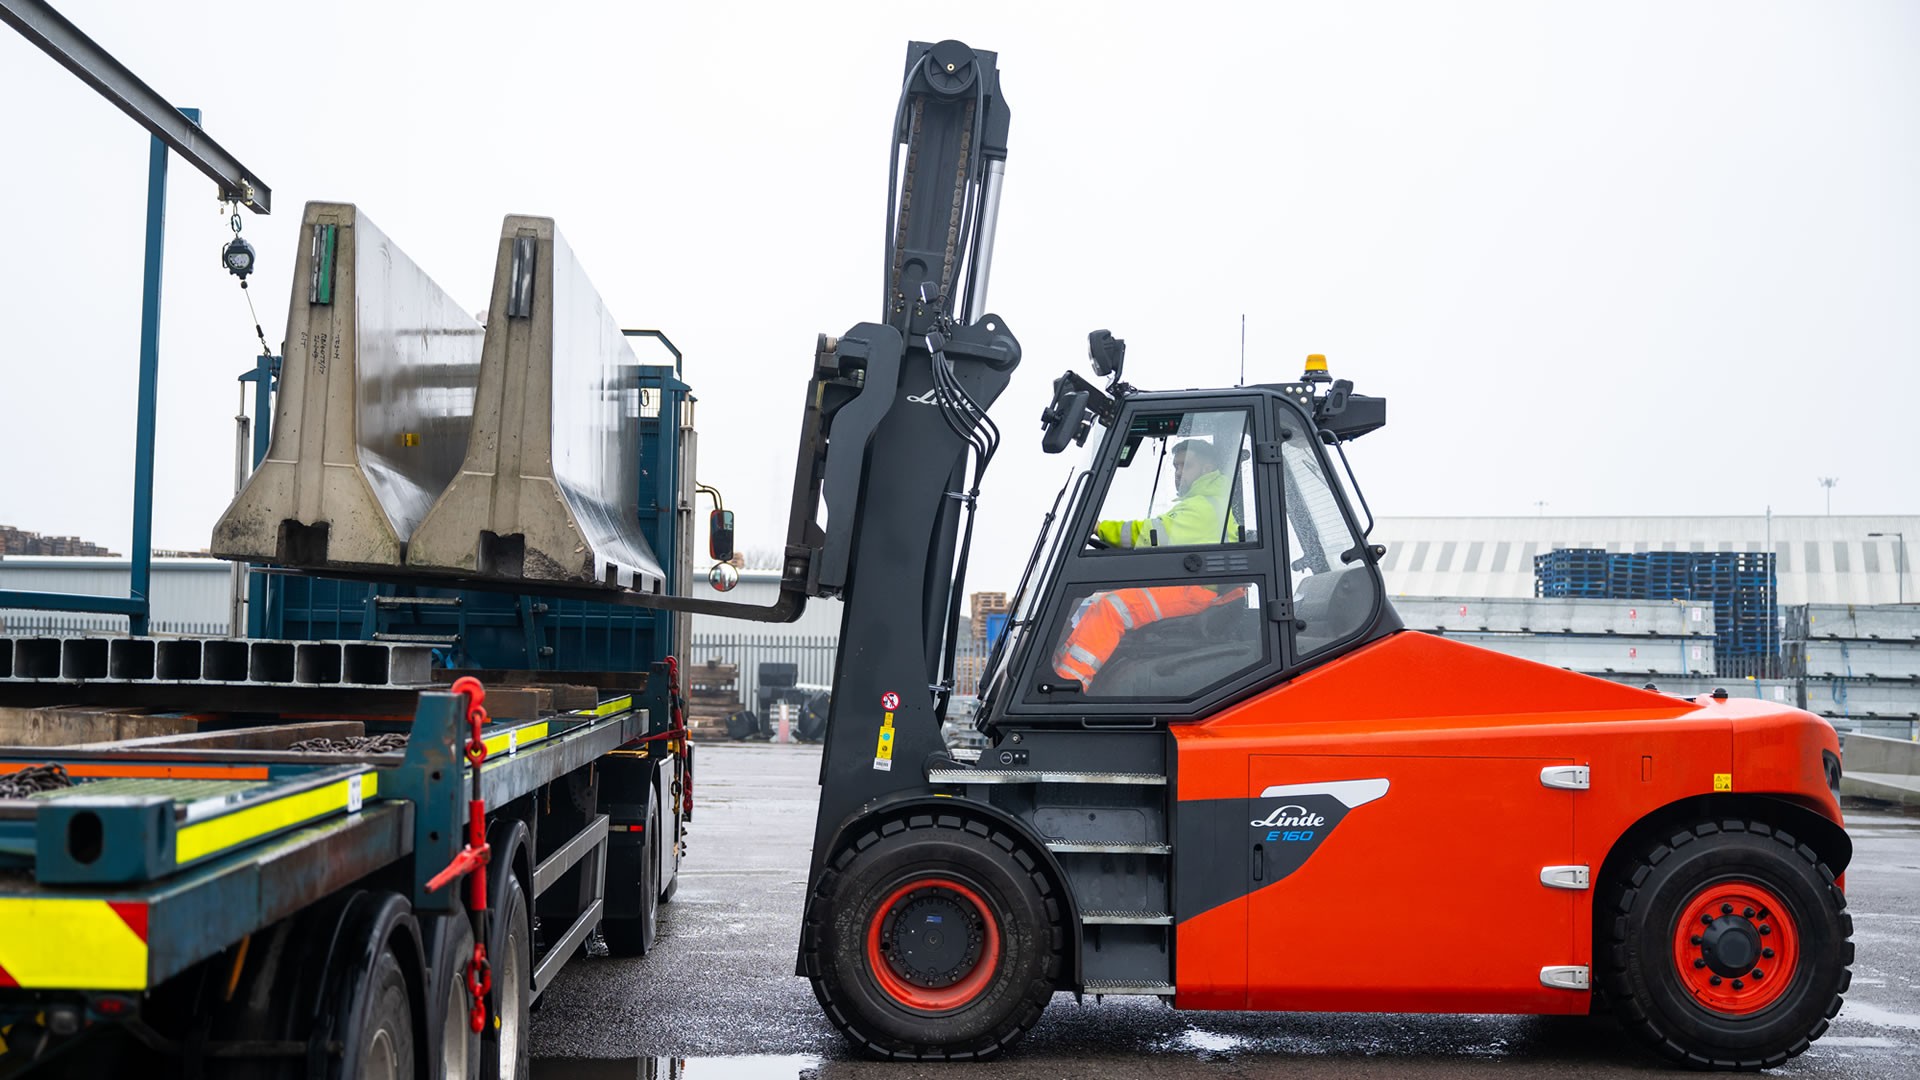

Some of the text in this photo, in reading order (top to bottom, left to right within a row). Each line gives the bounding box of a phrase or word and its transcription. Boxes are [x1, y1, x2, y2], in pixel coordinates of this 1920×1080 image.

[1250, 804, 1325, 827] Linde
[1265, 830, 1315, 841] E 160
